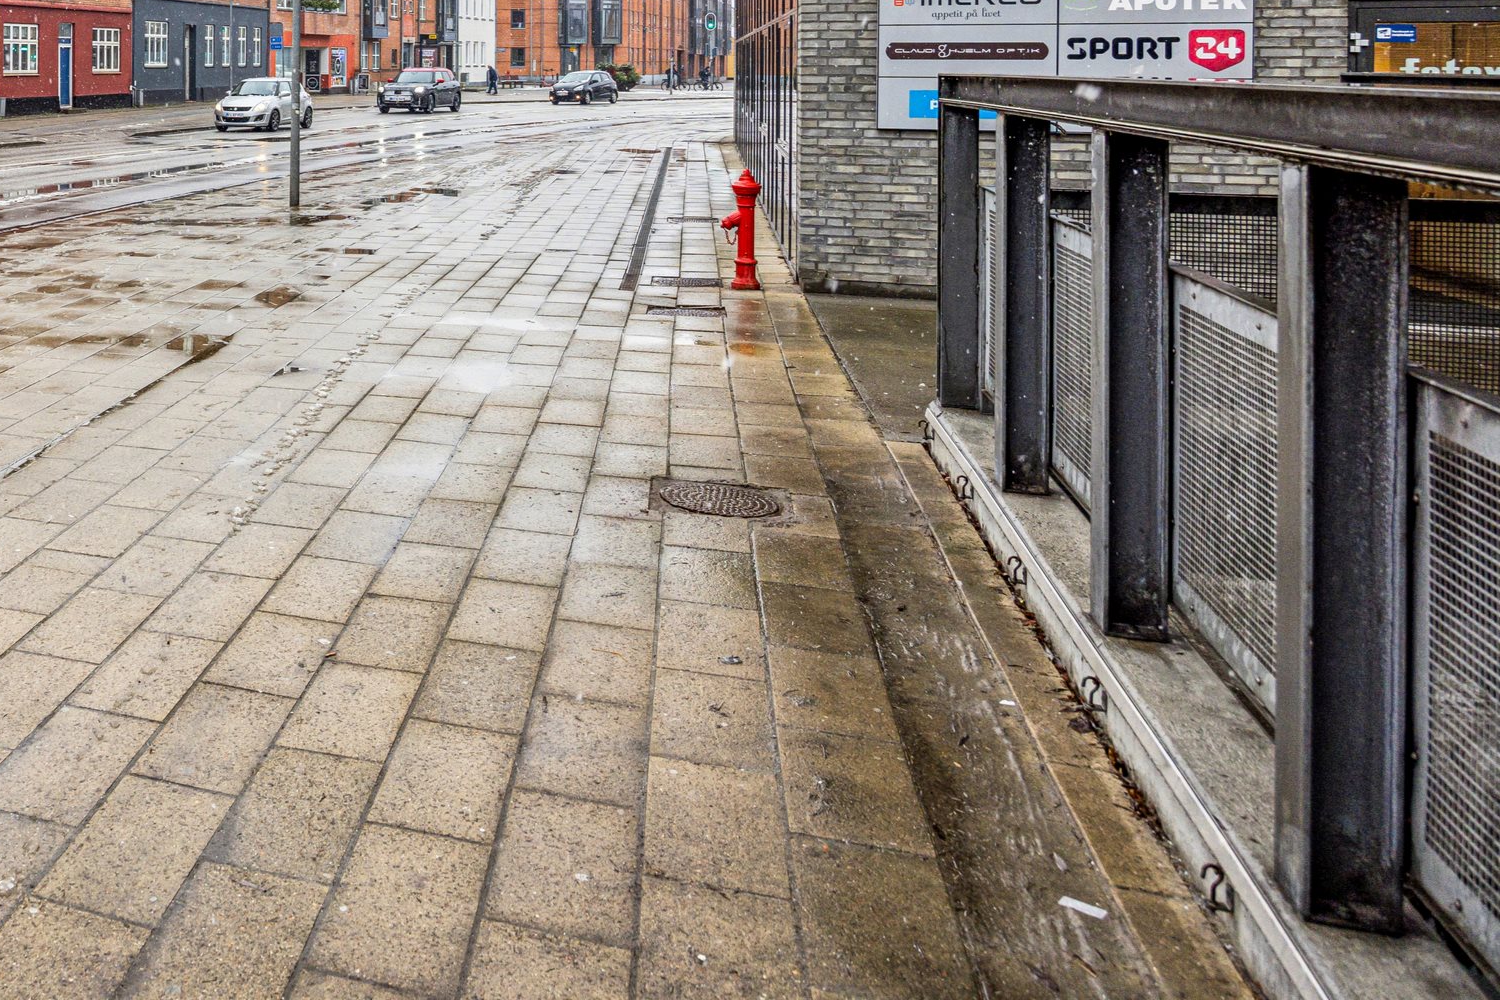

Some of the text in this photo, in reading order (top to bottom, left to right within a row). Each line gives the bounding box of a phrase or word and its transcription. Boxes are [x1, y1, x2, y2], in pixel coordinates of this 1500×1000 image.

[931, 7, 1002, 20] appetit på livet
[1066, 36, 1243, 61] SPORT 24
